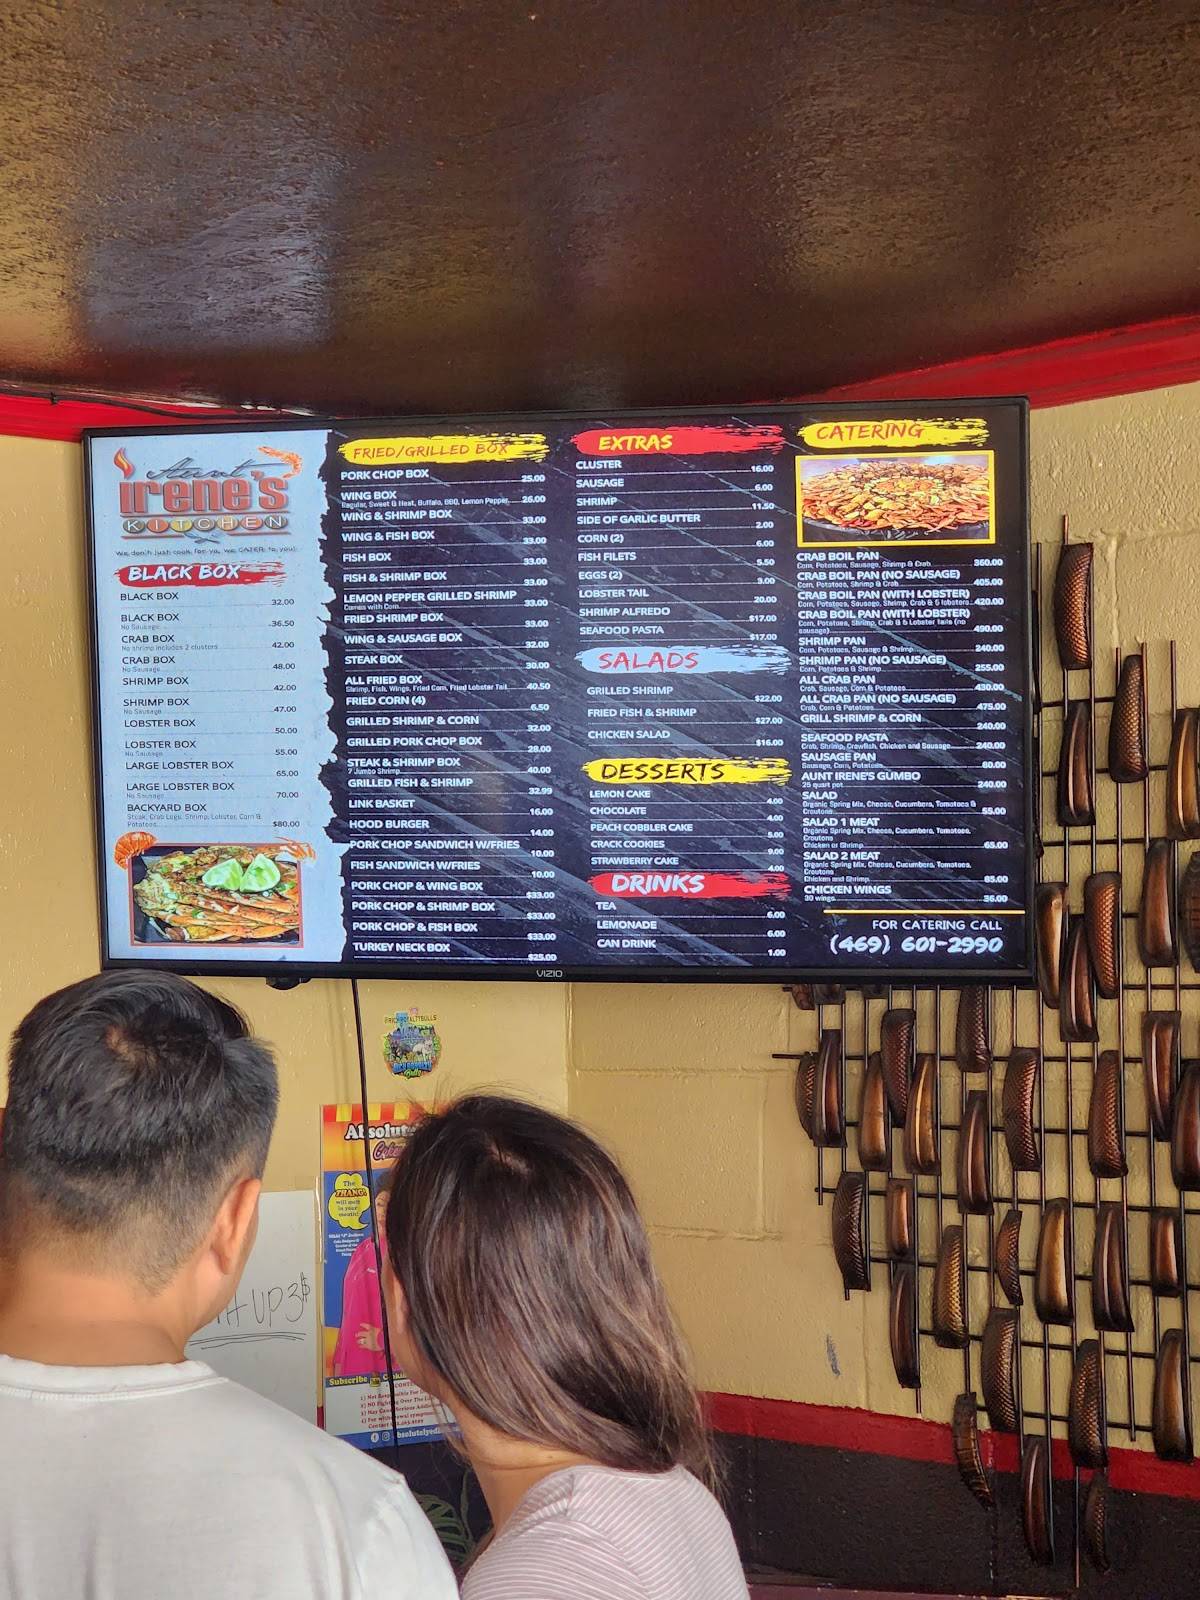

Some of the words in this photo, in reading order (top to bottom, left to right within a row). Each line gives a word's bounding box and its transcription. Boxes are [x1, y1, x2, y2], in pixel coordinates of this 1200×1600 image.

[816, 423, 925, 441] CATERING
[598, 435, 673, 450] EXTRAS
[354, 445, 469, 458] FRIED/GRILLED
[476, 442, 510, 454] BOX
[576, 460, 622, 469] CLUSTER
[751, 465, 774, 473] 16.00
[341, 471, 370, 480] PORK
[372, 470, 404, 479] CHOP
[406, 469, 429, 478] BOX
[576, 479, 624, 488] SAUSAGE
[341, 492, 371, 500] WING
[373, 491, 397, 500] BOX
[522, 495, 546, 503] 26.00
[577, 497, 618, 506] SHRIMP
[342, 513, 372, 521] WING
[374, 512, 383, 520] &
[385, 511, 426, 520] SHRIMP
[429, 510, 452, 519] BOX
[523, 516, 546, 524] 33.00
[122, 516, 288, 534] KITCHEN
[343, 554, 366, 562] FISH
[369, 553, 392, 561] BOX
[524, 557, 547, 565] 33.00
[797, 553, 825, 561] CRAB
[828, 552, 855, 561] BOIL
[856, 552, 879, 561] PAN
[128, 566, 193, 581] BLACK
[199, 565, 241, 579] BOX
[120, 593, 154, 601] BLACK
[157, 592, 179, 600] BOX
[344, 594, 382, 603] LEMON
[385, 593, 425, 602] PEPPER
[427, 592, 471, 601] GRILLED
[474, 591, 517, 600] SHRIMP
[579, 589, 625, 598] LOBSTER
[627, 589, 649, 597] TAIL
[524, 599, 548, 607] 33.00
[754, 596, 777, 604] 20.00
[121, 614, 154, 622] BLACK
[157, 613, 179, 621] BOX
[122, 635, 150, 643] CRAB
[153, 634, 175, 643] BOX
[345, 655, 378, 664] STEAK
[380, 655, 403, 664] BOX
[599, 652, 701, 671] SALADS
[799, 656, 841, 665] SHRIMP
[843, 656, 867, 664] PAN
[868, 655, 891, 665] (NO
[892, 655, 946, 665] SAUSAGE)
[975, 664, 1004, 672] 255.00
[122, 677, 163, 686] SHRIMP
[167, 677, 189, 685] BOX
[346, 697, 376, 705] FRIED
[378, 696, 409, 705] CORN
[412, 696, 426, 706] (4)
[588, 708, 617, 718] FRIED
[620, 708, 643, 717] FISH
[645, 708, 654, 717] &
[656, 708, 697, 717] SHRIMP
[124, 719, 170, 728] LOBSTER
[174, 719, 196, 727] BOX
[756, 717, 783, 725] $27.00
[588, 730, 632, 739] CHICKEN
[635, 730, 670, 739] SALAD
[756, 738, 784, 747] $16.00
[125, 762, 159, 770] LARGE
[162, 761, 208, 770] LOBSTER
[211, 761, 234, 769] BOX
[601, 763, 725, 781] DESSERTS
[801, 772, 833, 780] AUNT
[835, 772, 875, 780] IRENE'S
[877, 772, 921, 781] GUMBO
[126, 783, 160, 792] LARGE
[163, 783, 209, 791] LOBSTER
[212, 782, 235, 791] BOX
[978, 781, 1007, 789] 240.00
[276, 791, 299, 799] 70.00
[590, 791, 624, 799] LEMON
[626, 790, 650, 798] CAKE
[802, 792, 837, 800] SALAD
[127, 804, 181, 813] BACKYARD
[185, 804, 207, 812] BOX
[349, 800, 373, 808] LINK
[375, 800, 415, 808] BASKET
[530, 808, 553, 816] 16.00
[273, 820, 300, 828] $80.00
[349, 820, 383, 829] HOOD
[386, 820, 429, 829] BURGER
[530, 829, 554, 837] 14.00
[611, 874, 705, 894] DRINKS
[804, 886, 852, 894] CHICKEN
[854, 886, 892, 894] WINGS
[596, 902, 616, 910] TEA
[767, 911, 785, 919] 6.00
[597, 920, 657, 929] LEMONADE
[872, 920, 898, 930] FOR
[902, 920, 965, 930] CATERING
[970, 921, 1002, 930] CALL
[767, 930, 786, 938] 6.00
[353, 943, 393, 951] TURKEY
[396, 943, 425, 952] NECK
[427, 943, 450, 952] BOX
[597, 939, 620, 948] CAN
[622, 939, 656, 948] DRINK
[830, 934, 891, 954] (469)
[901, 936, 1003, 953] 601-2990
[528, 953, 556, 962] $25.00
[768, 949, 786, 957] 1.00
[537, 970, 562, 978] VIZIO
[329, 1376, 367, 1385] Subscribe
